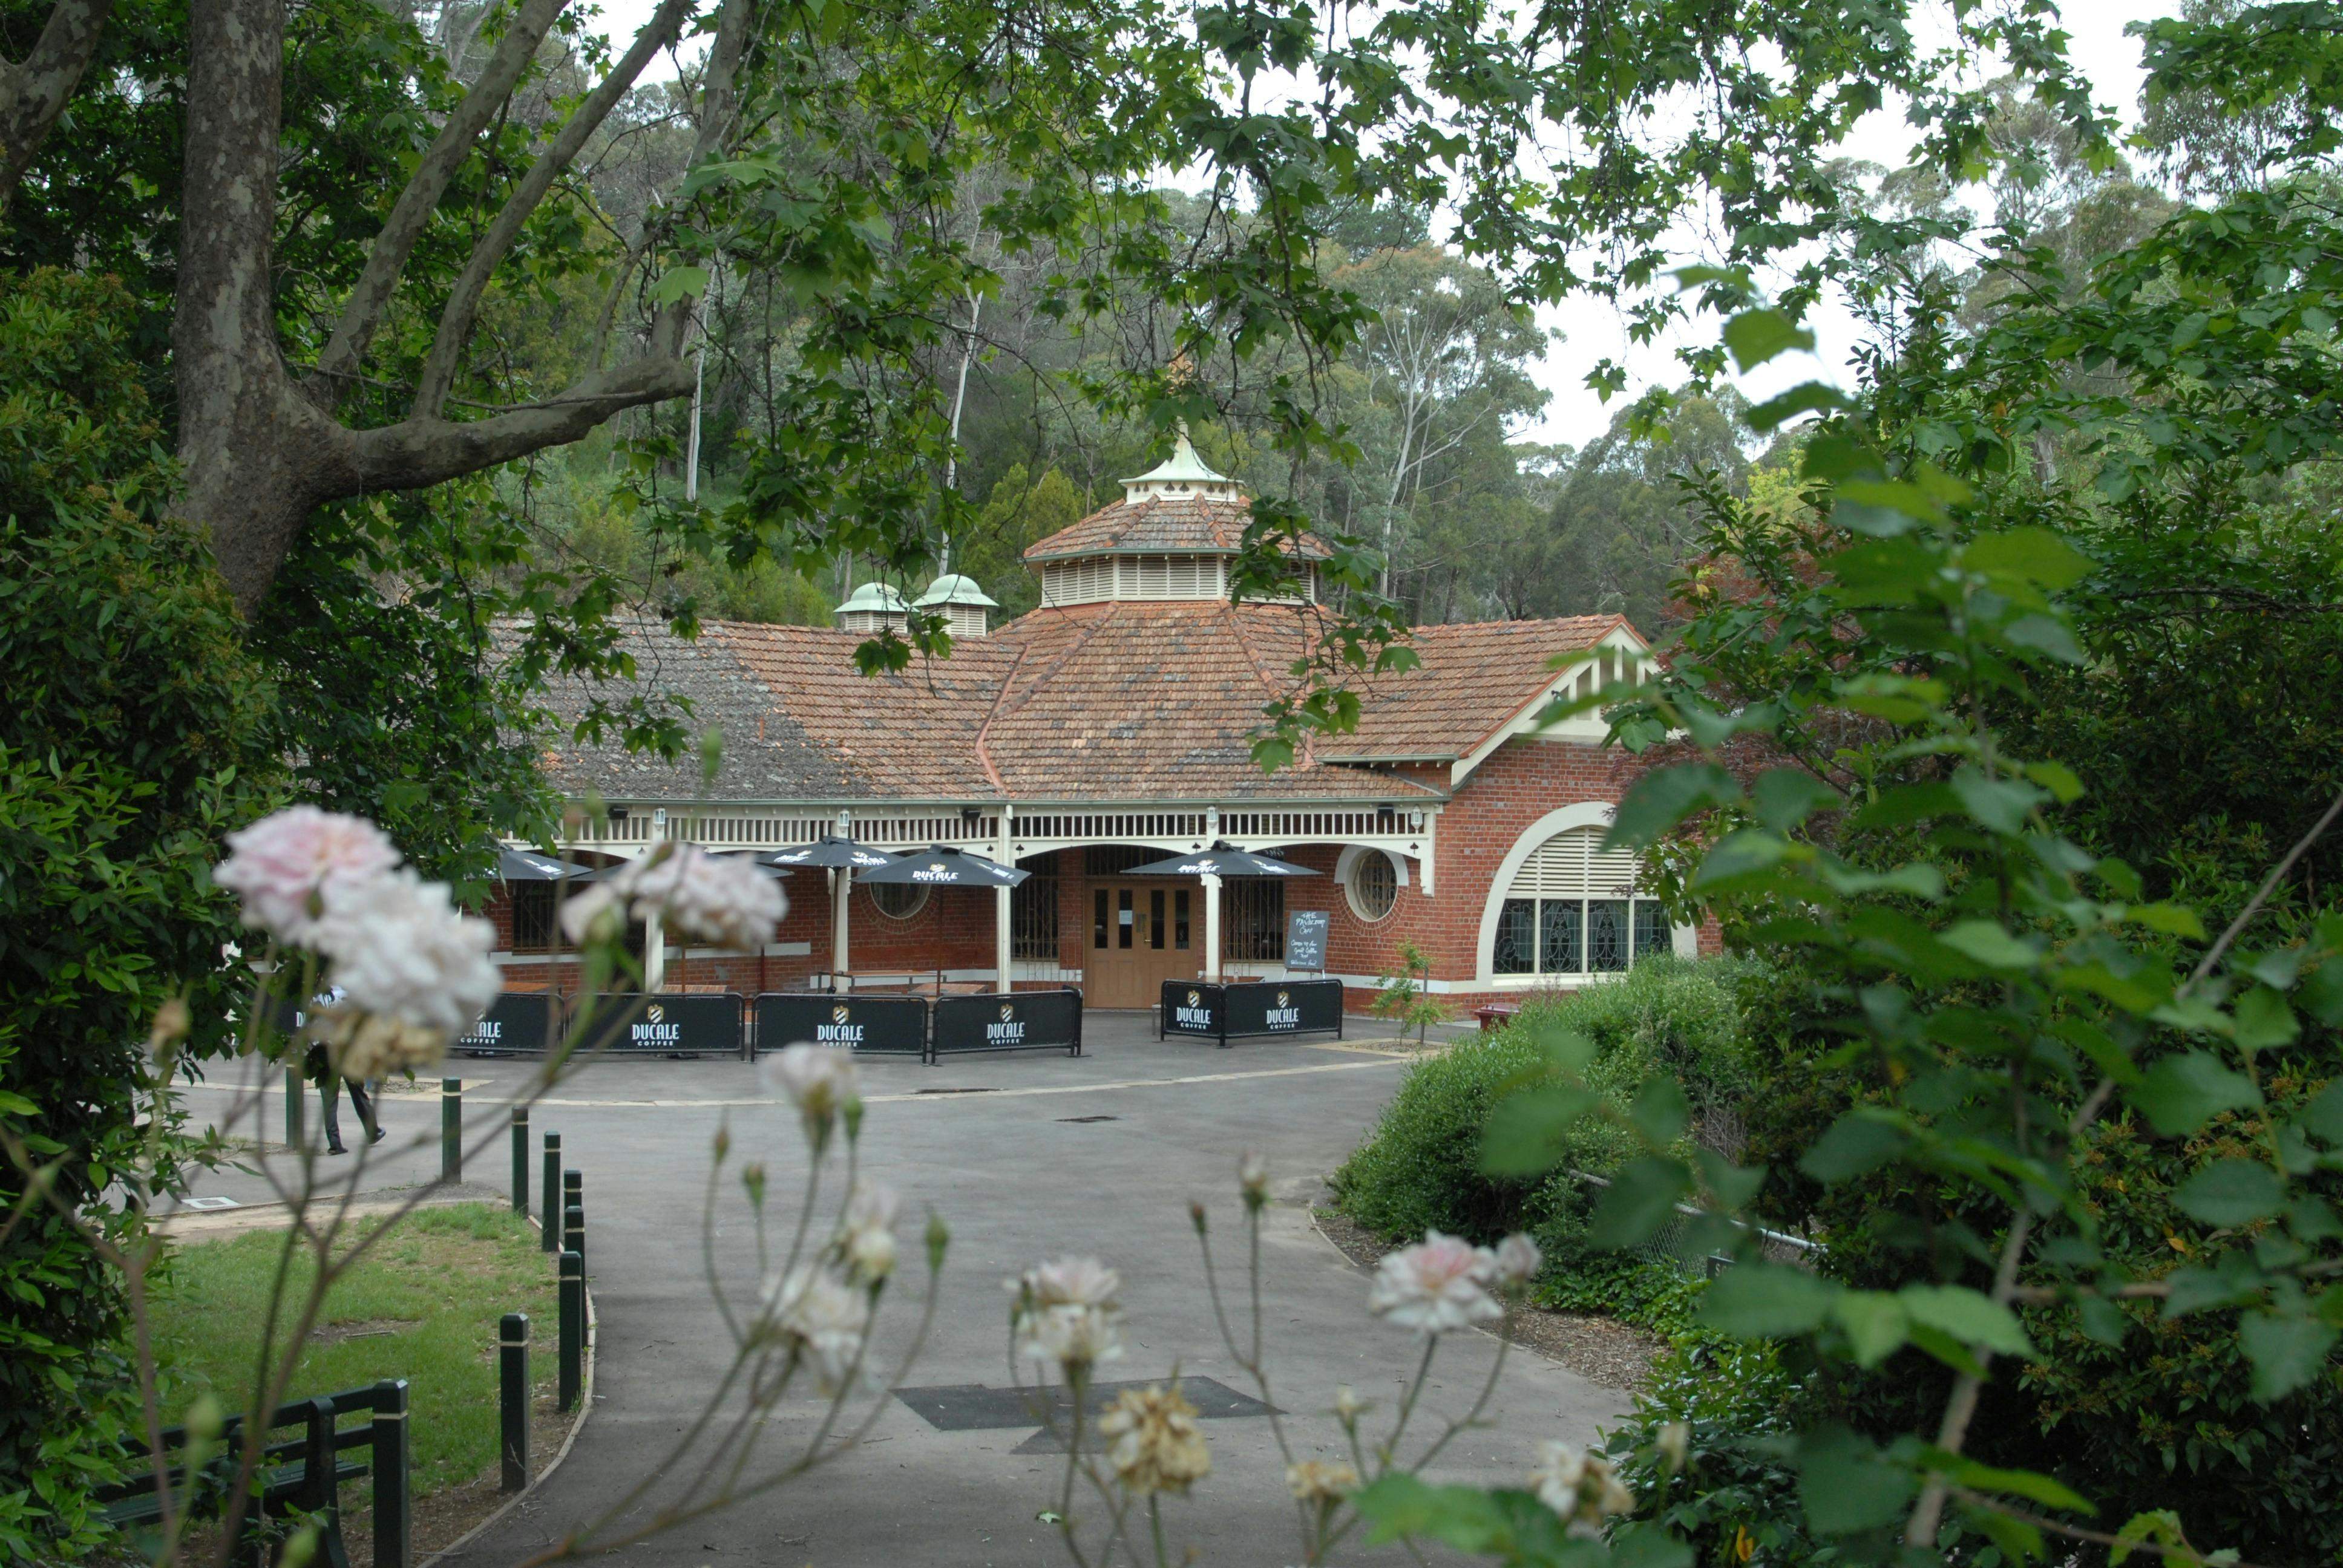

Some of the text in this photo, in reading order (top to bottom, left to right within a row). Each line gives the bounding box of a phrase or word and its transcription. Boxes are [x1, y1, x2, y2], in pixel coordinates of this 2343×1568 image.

[913, 871, 958, 880] DUCALE
[1300, 912, 1317, 920] THE
[1176, 1007, 1211, 1024] DUCALE
[1267, 1008, 1299, 1024] DUCALE
[632, 1024, 680, 1040] DUCALE
[817, 1025, 864, 1041] DUCALE
[986, 1022, 1025, 1039] DUCALE
